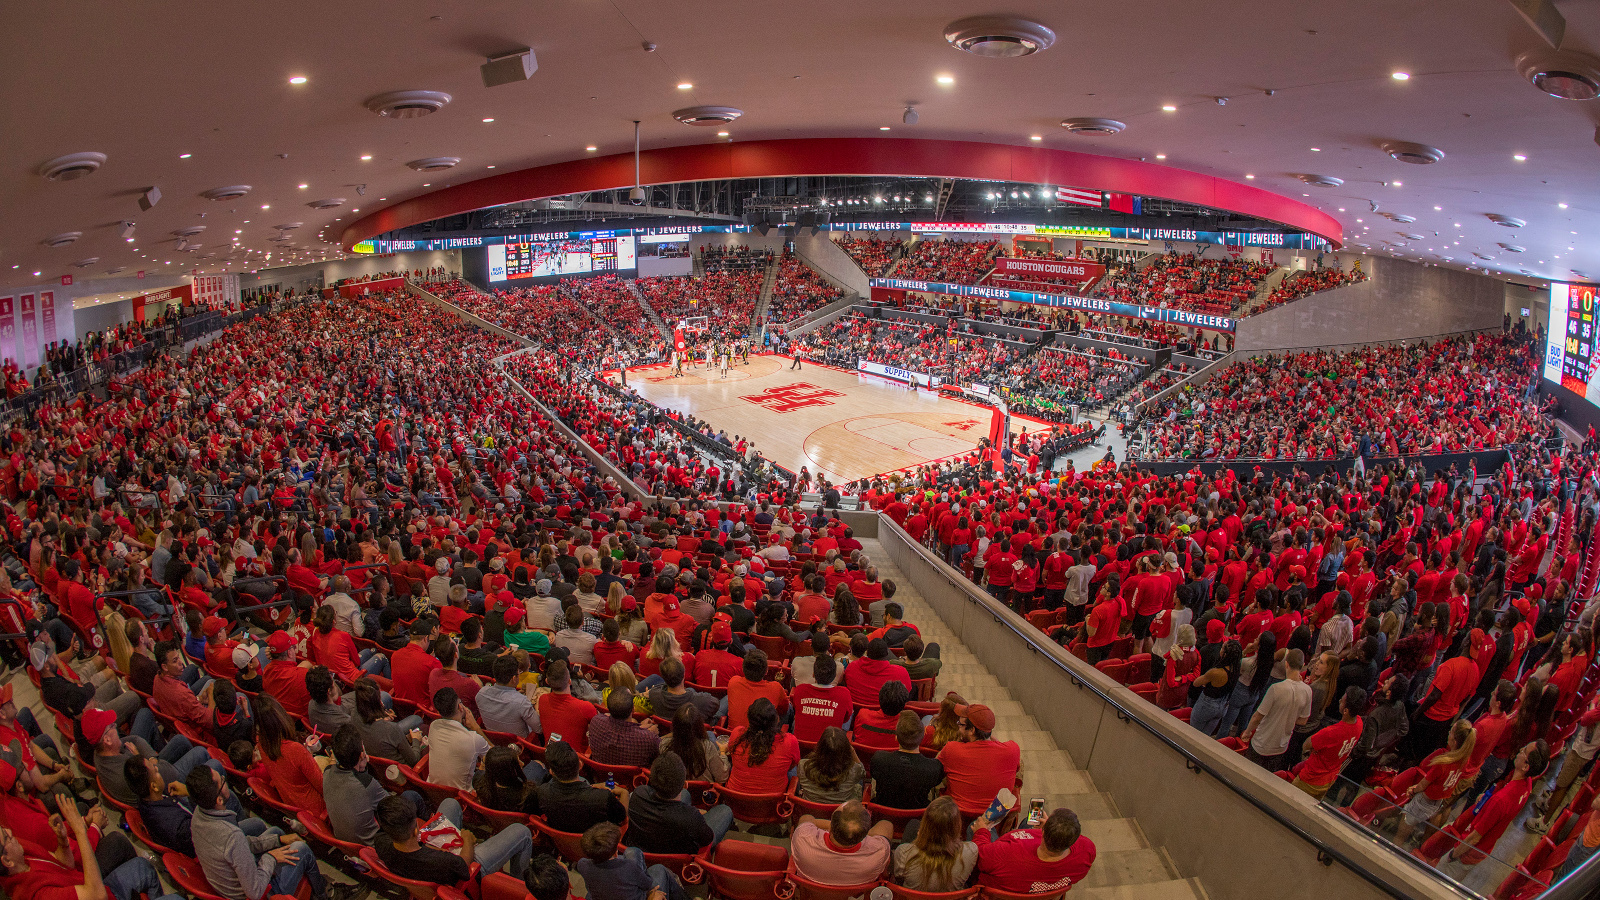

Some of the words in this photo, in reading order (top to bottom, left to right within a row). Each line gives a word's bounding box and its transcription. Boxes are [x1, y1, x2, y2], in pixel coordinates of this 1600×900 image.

[659, 225, 703, 234] JEWELERS
[858, 222, 901, 230] JEWELERS
[529, 231, 569, 241] JEWELERS
[1153, 229, 1197, 240] JEWELERS
[1247, 233, 1284, 246] JEWELERS
[392, 240, 416, 250] JEWELERS
[449, 237, 482, 247] JEWELERS
[1227, 245, 1243, 253] SMU
[1006, 261, 1044, 272] HOUSTON
[1045, 264, 1085, 276] COUGARS
[895, 280, 928, 290] JEWELERS
[970, 286, 1010, 298] JEWELERS
[1062, 296, 1110, 311] JEWELERS
[1173, 311, 1230, 328] JEWELERS
[1582, 323, 1591, 338] 35
[1550, 345, 1561, 357] BUD
[1547, 355, 1561, 369] LIGHT
[884, 366, 911, 379] SUPPLY
[710, 669, 717, 687] 1
[801, 698, 831, 707] UNIVERSITY
[832, 701, 839, 709] OF
[802, 706, 835, 718] HOUSTON
